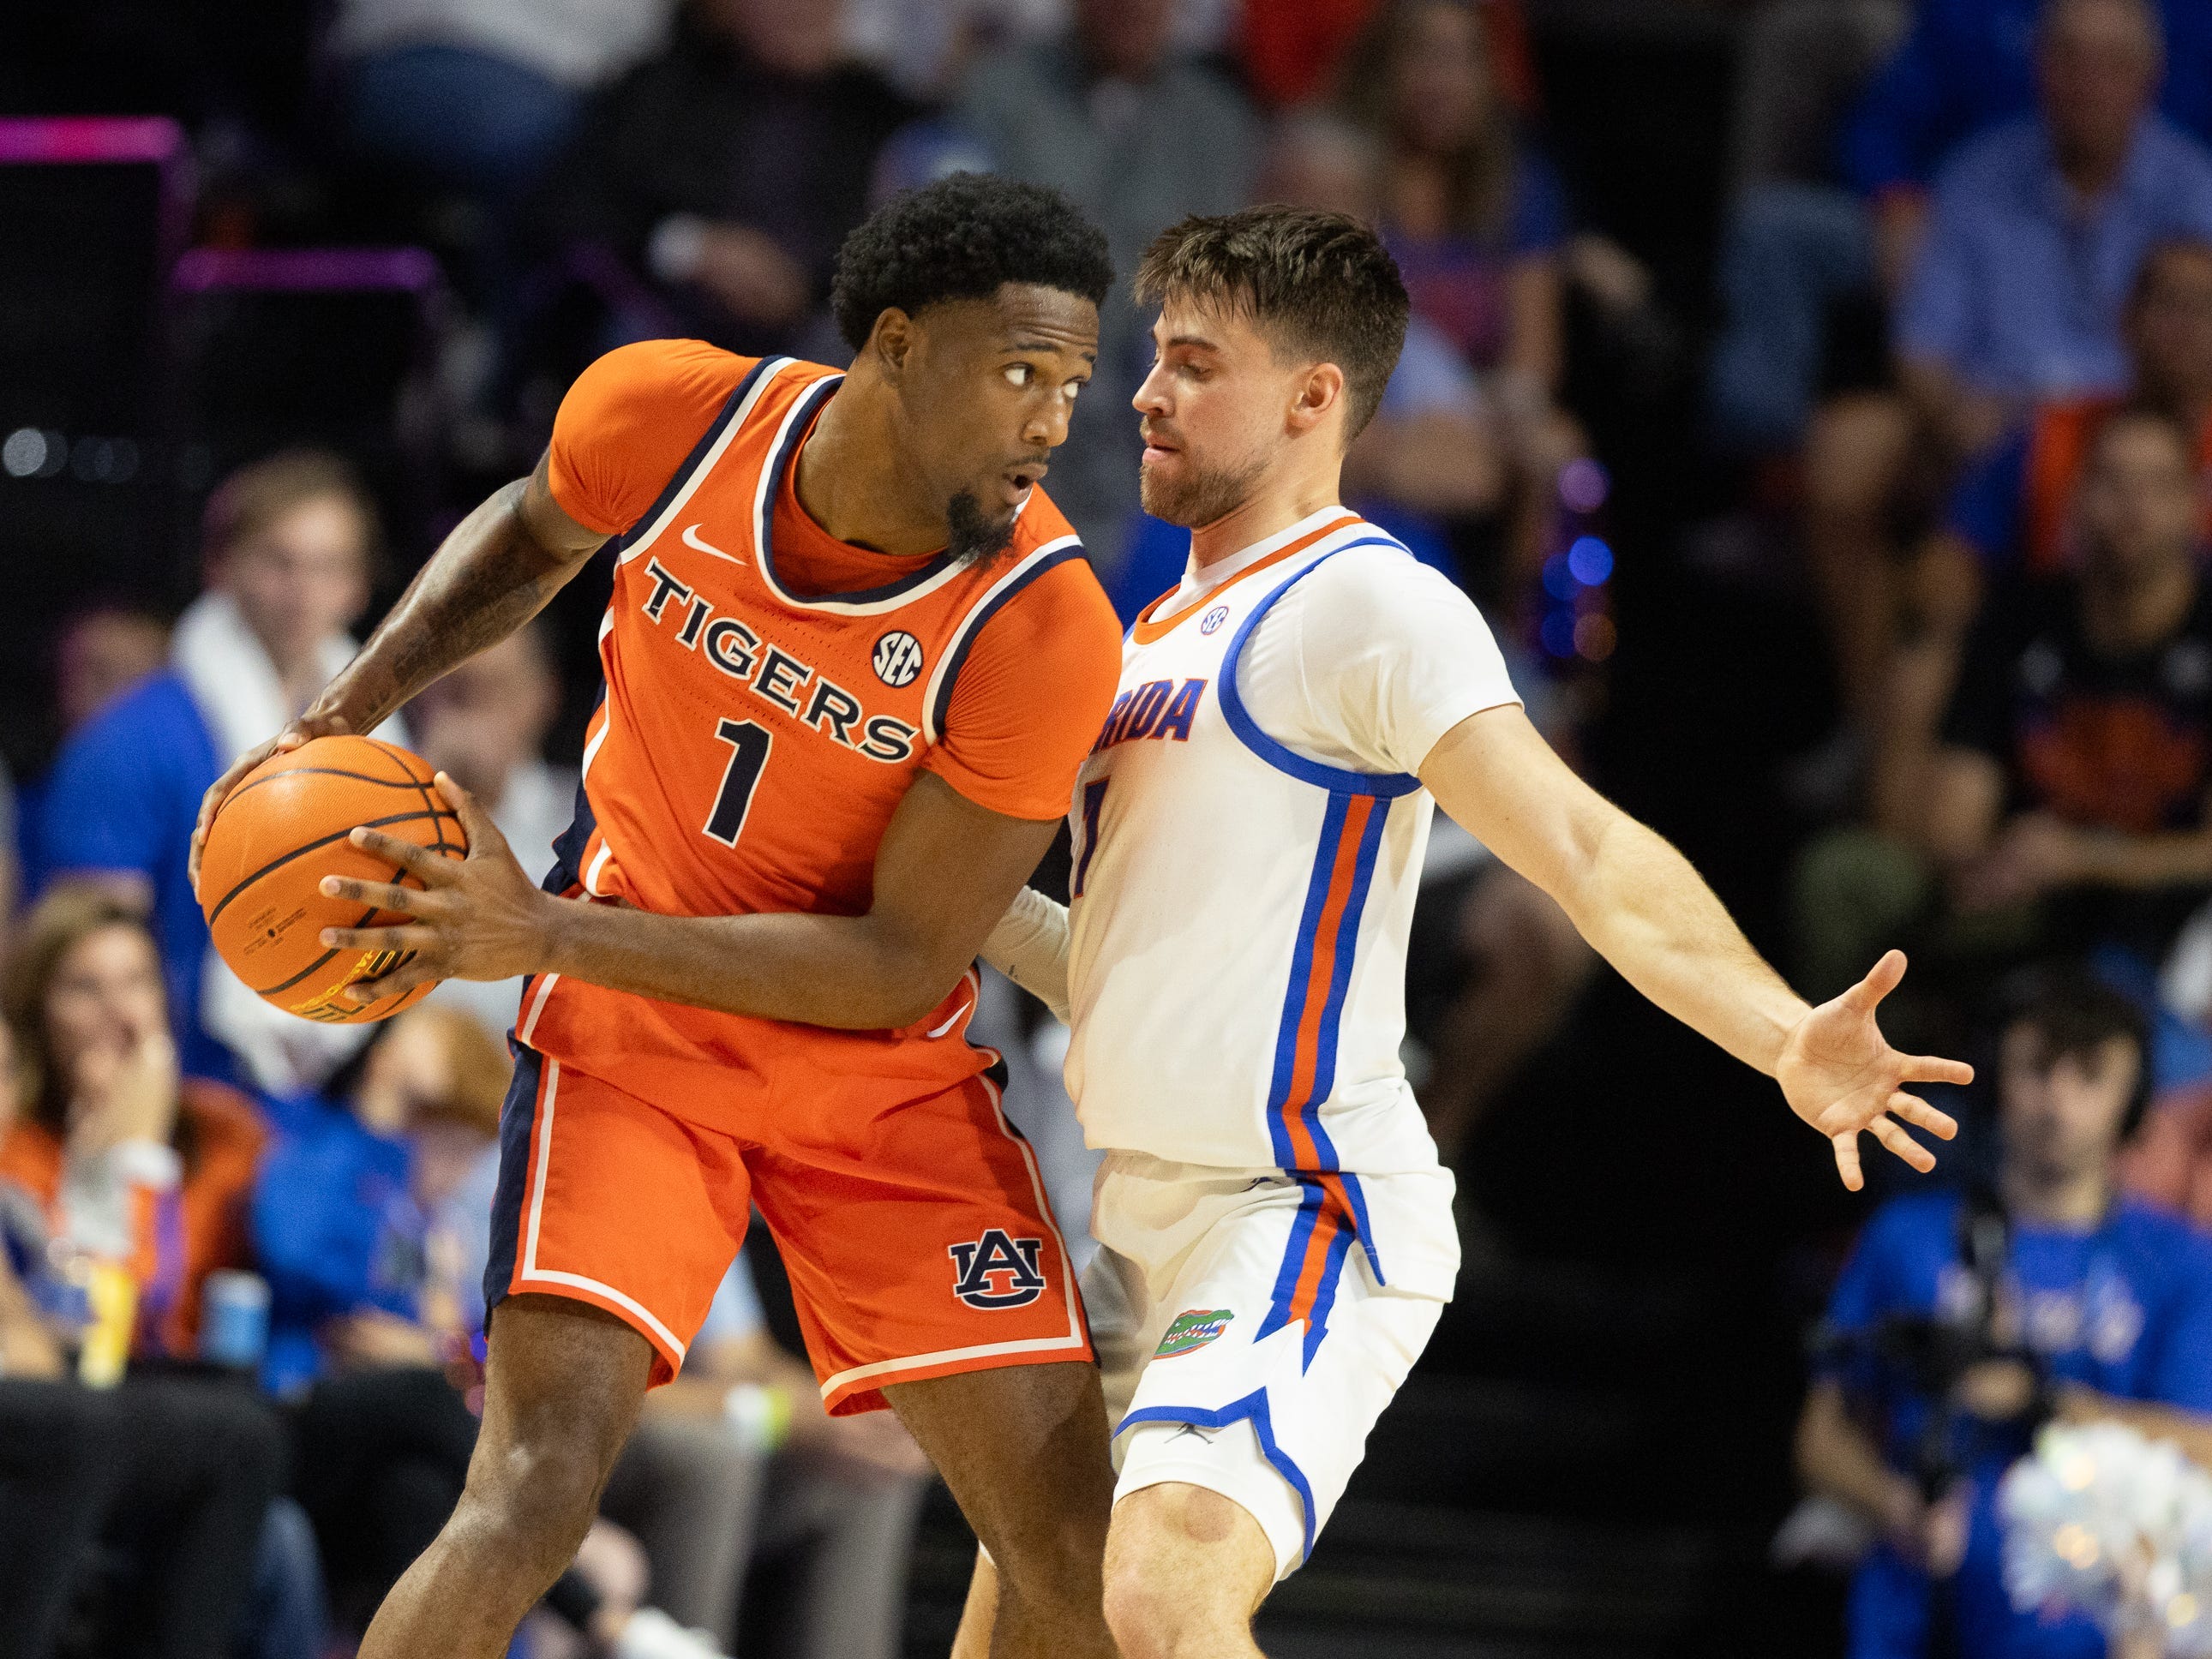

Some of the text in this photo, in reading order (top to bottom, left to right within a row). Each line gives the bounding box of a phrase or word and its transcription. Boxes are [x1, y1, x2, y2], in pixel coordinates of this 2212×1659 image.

[642, 556, 922, 764] TIGERS
[872, 632, 923, 686] SEC
[1202, 607, 1228, 634] SEC
[1088, 678, 1208, 755] RIDA
[702, 716, 773, 849] 1
[1074, 775, 1111, 899] 1
